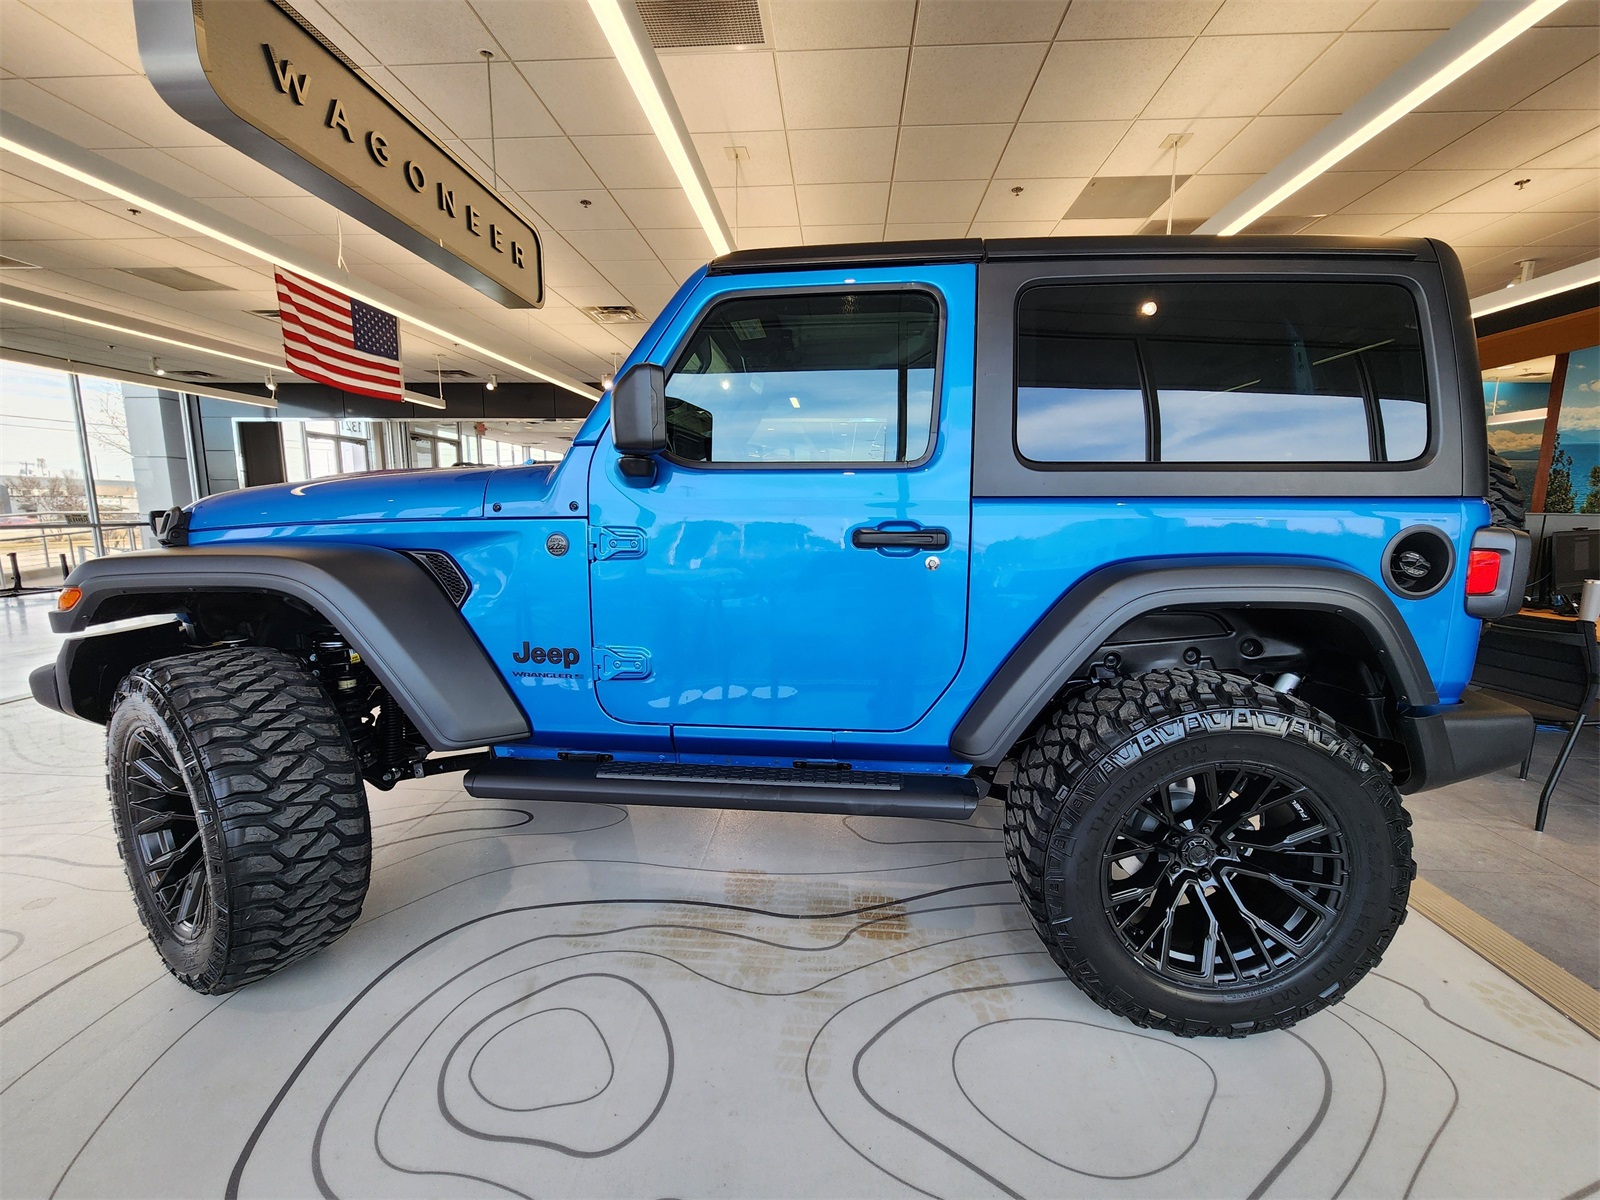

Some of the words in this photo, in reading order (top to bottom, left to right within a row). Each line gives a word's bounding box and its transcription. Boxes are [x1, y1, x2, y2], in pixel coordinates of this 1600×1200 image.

[261, 43, 525, 269] WAGONEER
[512, 641, 580, 669] Jeep
[512, 671, 573, 679] WRANGLER
[1087, 744, 1210, 835] THOMPSON
